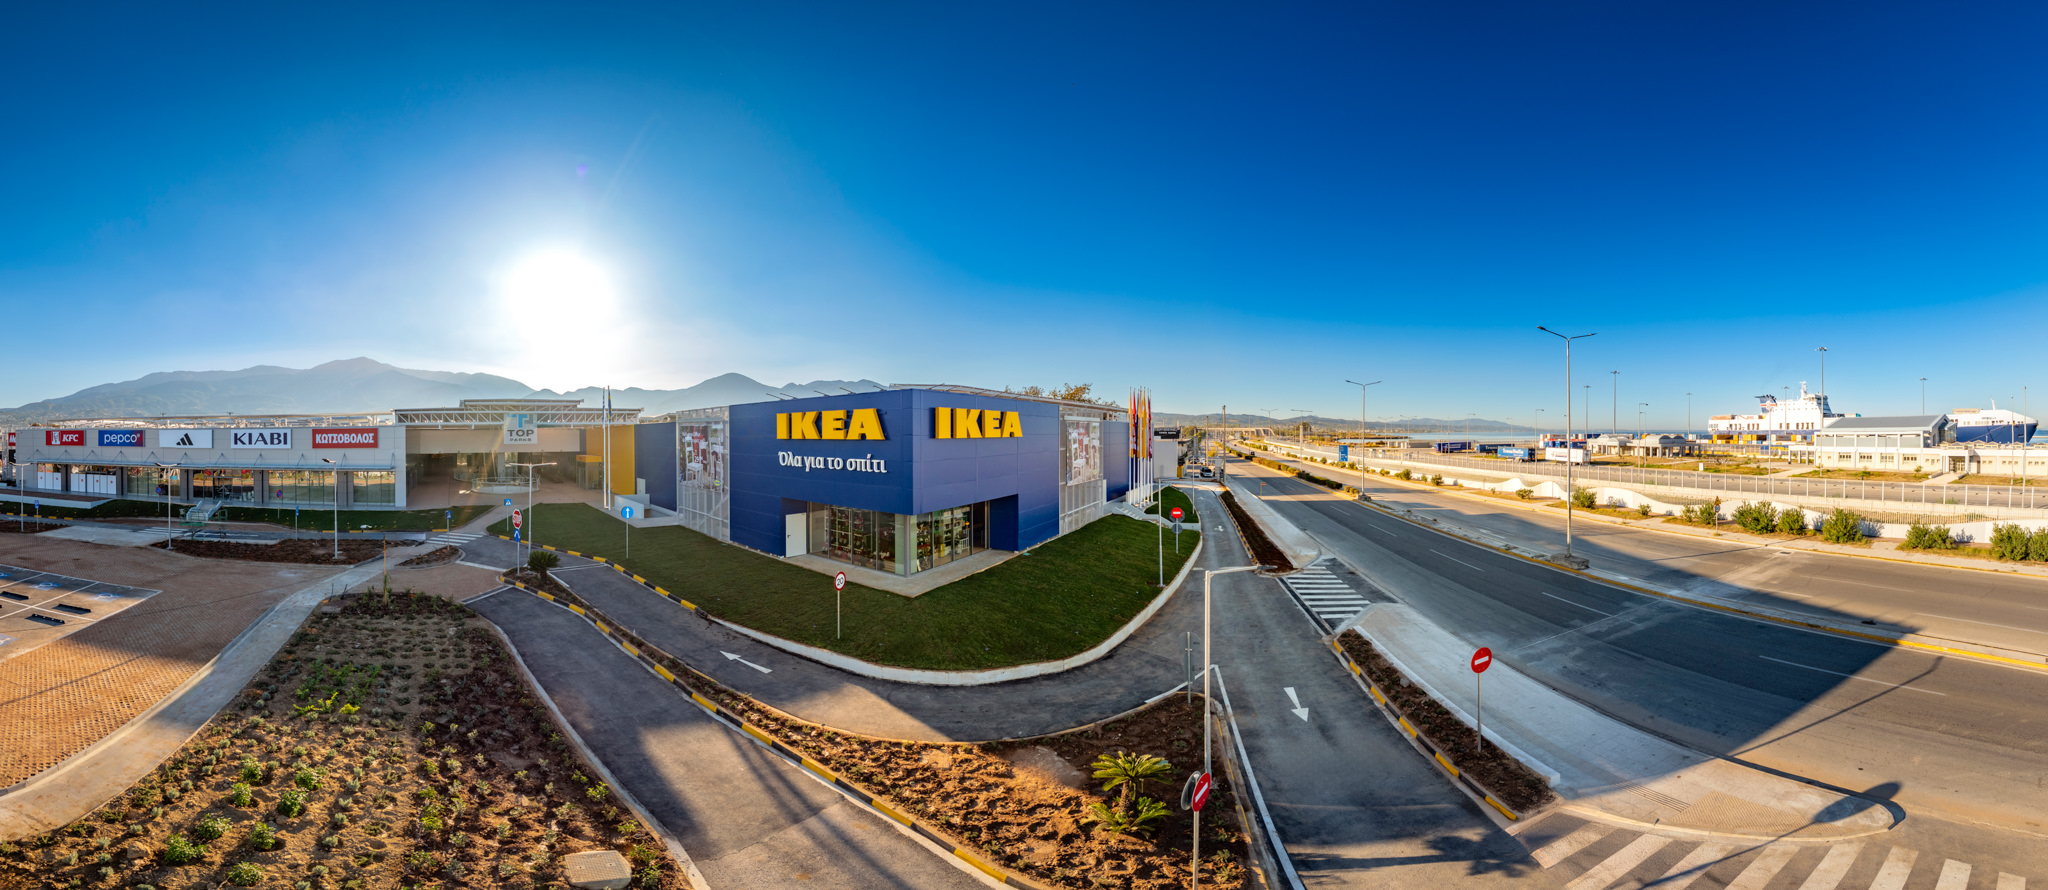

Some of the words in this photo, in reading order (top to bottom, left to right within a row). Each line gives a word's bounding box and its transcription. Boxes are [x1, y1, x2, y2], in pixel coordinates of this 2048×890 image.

[776, 408, 886, 440] IKEA
[935, 407, 1023, 439] IKEA
[62, 434, 79, 442] KFC
[234, 432, 287, 445] KIABI
[315, 433, 374, 444] ΚΩΤΣΟΒΟΛΟΣ
[778, 451, 803, 467] Όλα
[804, 455, 825, 472] για
[827, 457, 843, 470] το
[846, 453, 888, 473] σπίτι
[837, 577, 843, 586] 20
